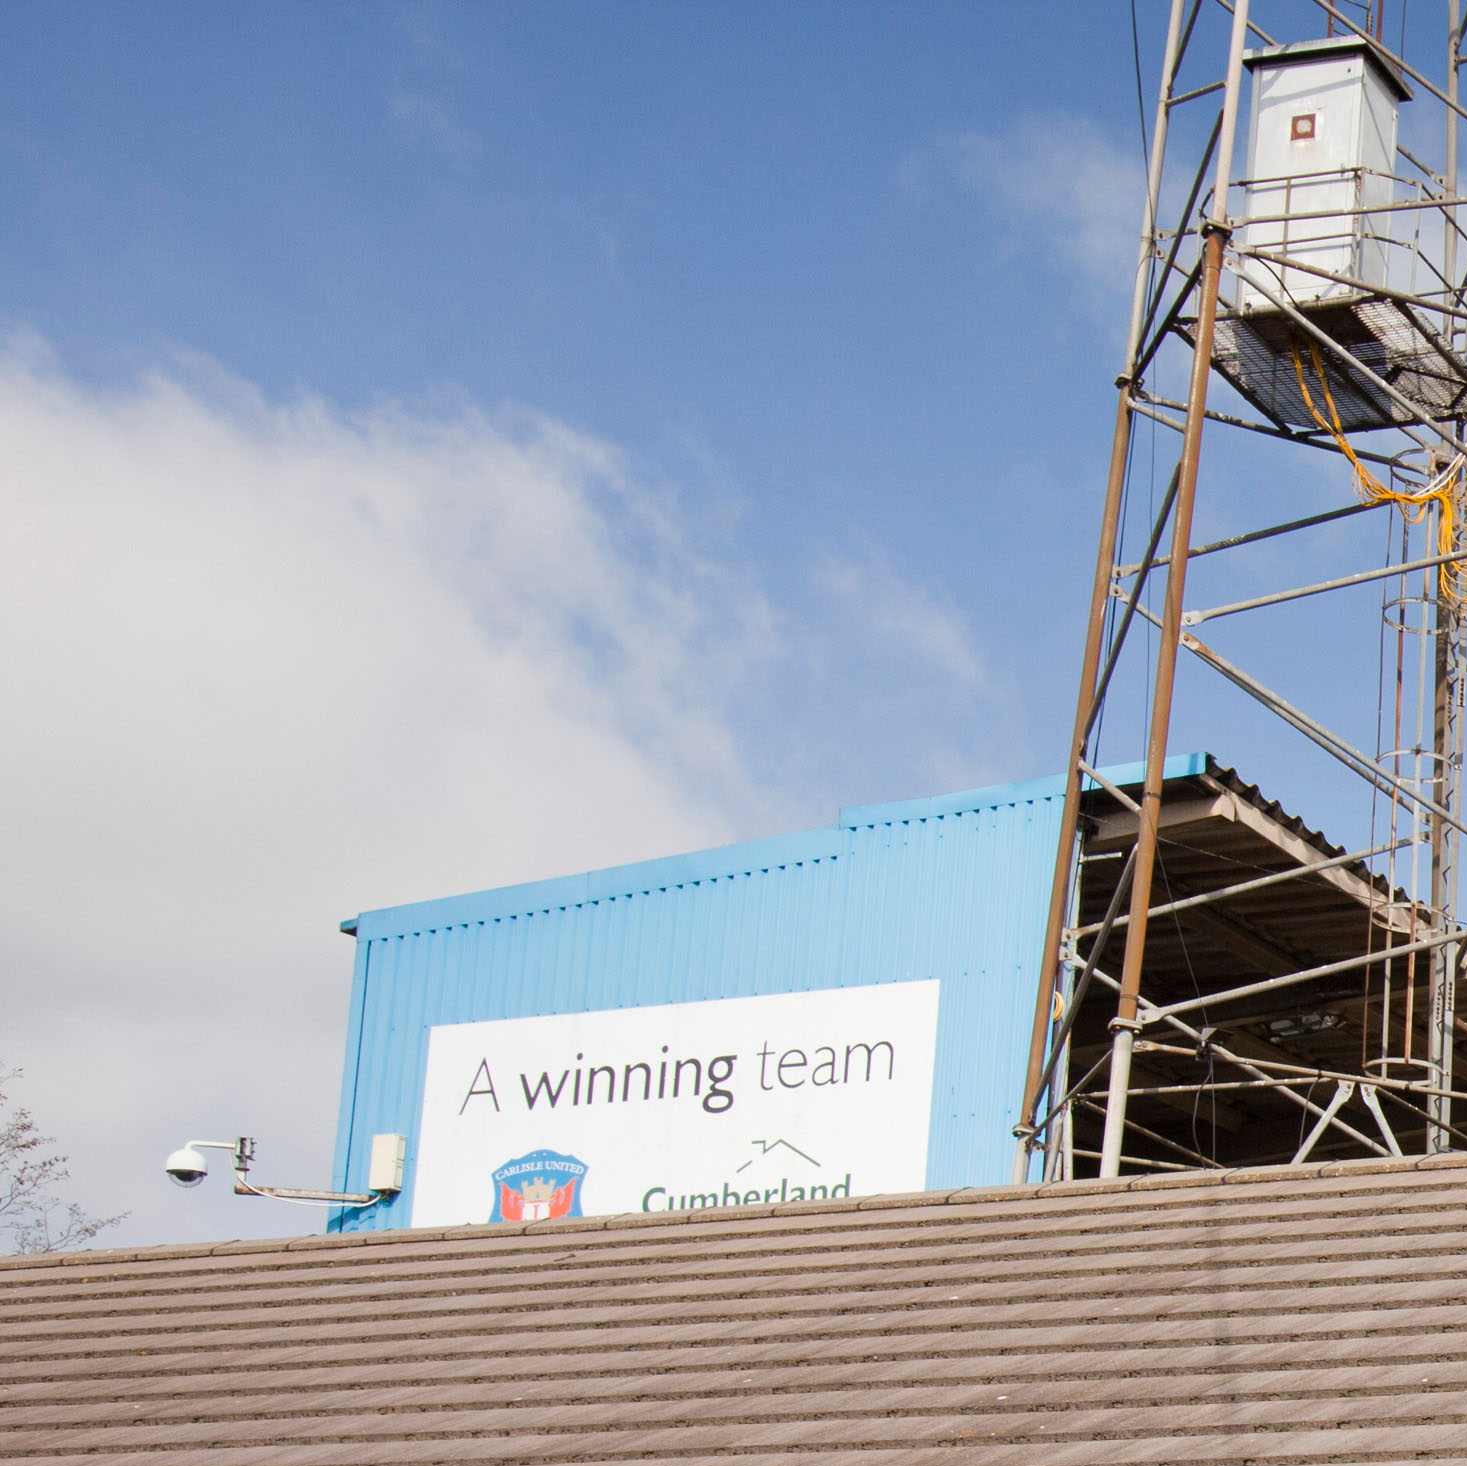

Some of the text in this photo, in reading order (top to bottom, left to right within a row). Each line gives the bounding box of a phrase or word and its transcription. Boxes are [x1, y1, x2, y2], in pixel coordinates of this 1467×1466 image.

[459, 1039, 894, 1116] A winning team
[496, 1160, 584, 1180] CARLISLE UNITED
